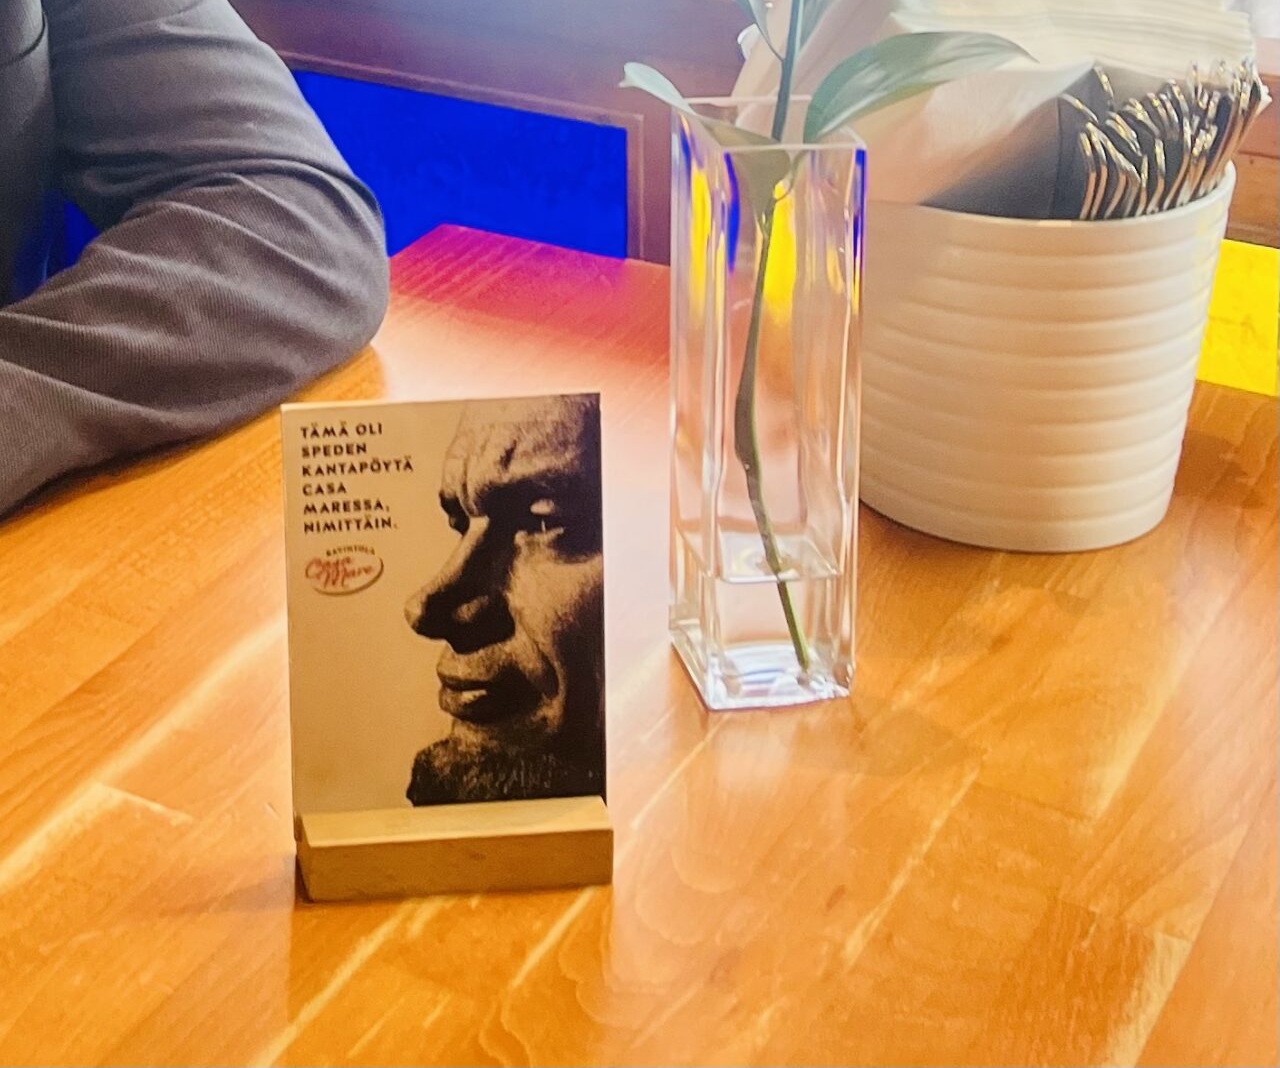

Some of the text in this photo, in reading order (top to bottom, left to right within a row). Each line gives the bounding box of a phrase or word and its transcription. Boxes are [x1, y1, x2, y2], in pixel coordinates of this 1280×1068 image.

[300, 420, 383, 439] TÄMÄ OLI
[301, 442, 367, 459] SPEDEN
[302, 456, 414, 477] KANTAPÖYTÄ
[302, 482, 347, 497] CASA
[304, 514, 398, 535] NIMITTÄIN.
